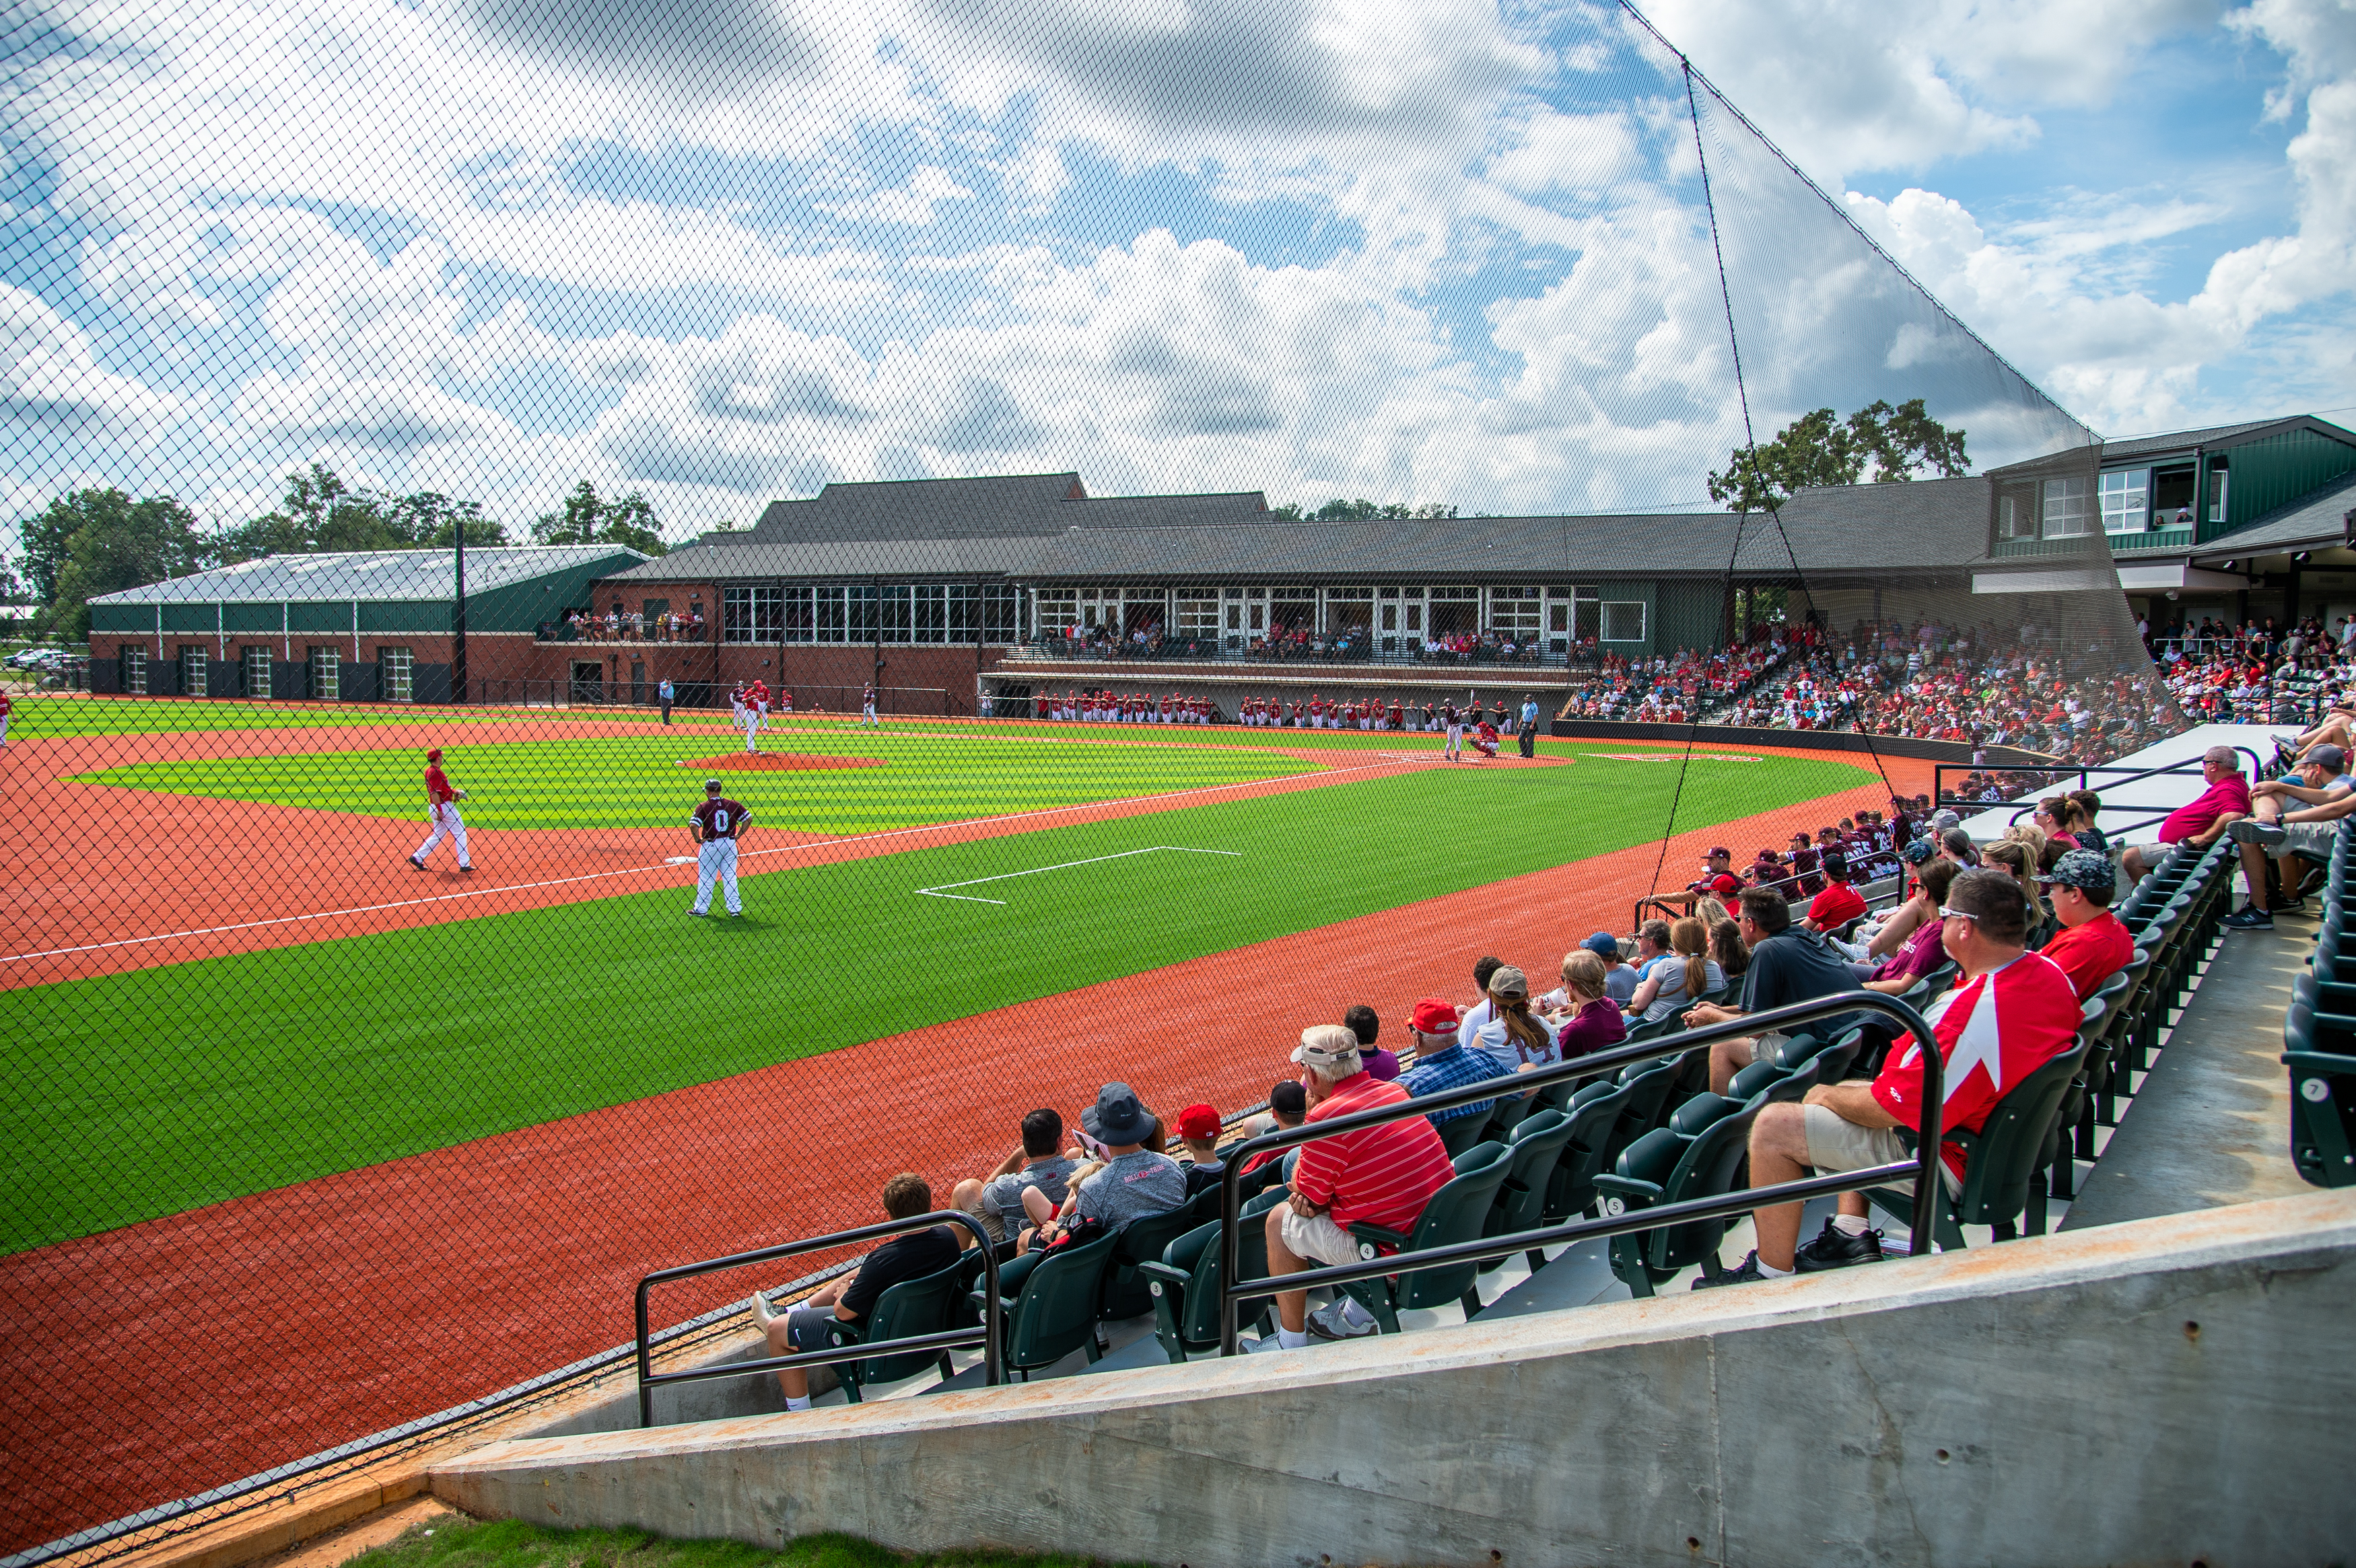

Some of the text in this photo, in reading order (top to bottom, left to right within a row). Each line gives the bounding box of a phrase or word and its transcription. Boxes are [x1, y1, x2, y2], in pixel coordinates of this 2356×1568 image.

[715, 810, 728, 832] 0
[2309, 1084, 2319, 1095] 7
[1124, 1164, 1165, 1183] ROLL TRIBE
[1612, 1201, 1618, 1211] 5
[1364, 1247, 1370, 1256] 4
[1154, 1285, 1158, 1293] 3
